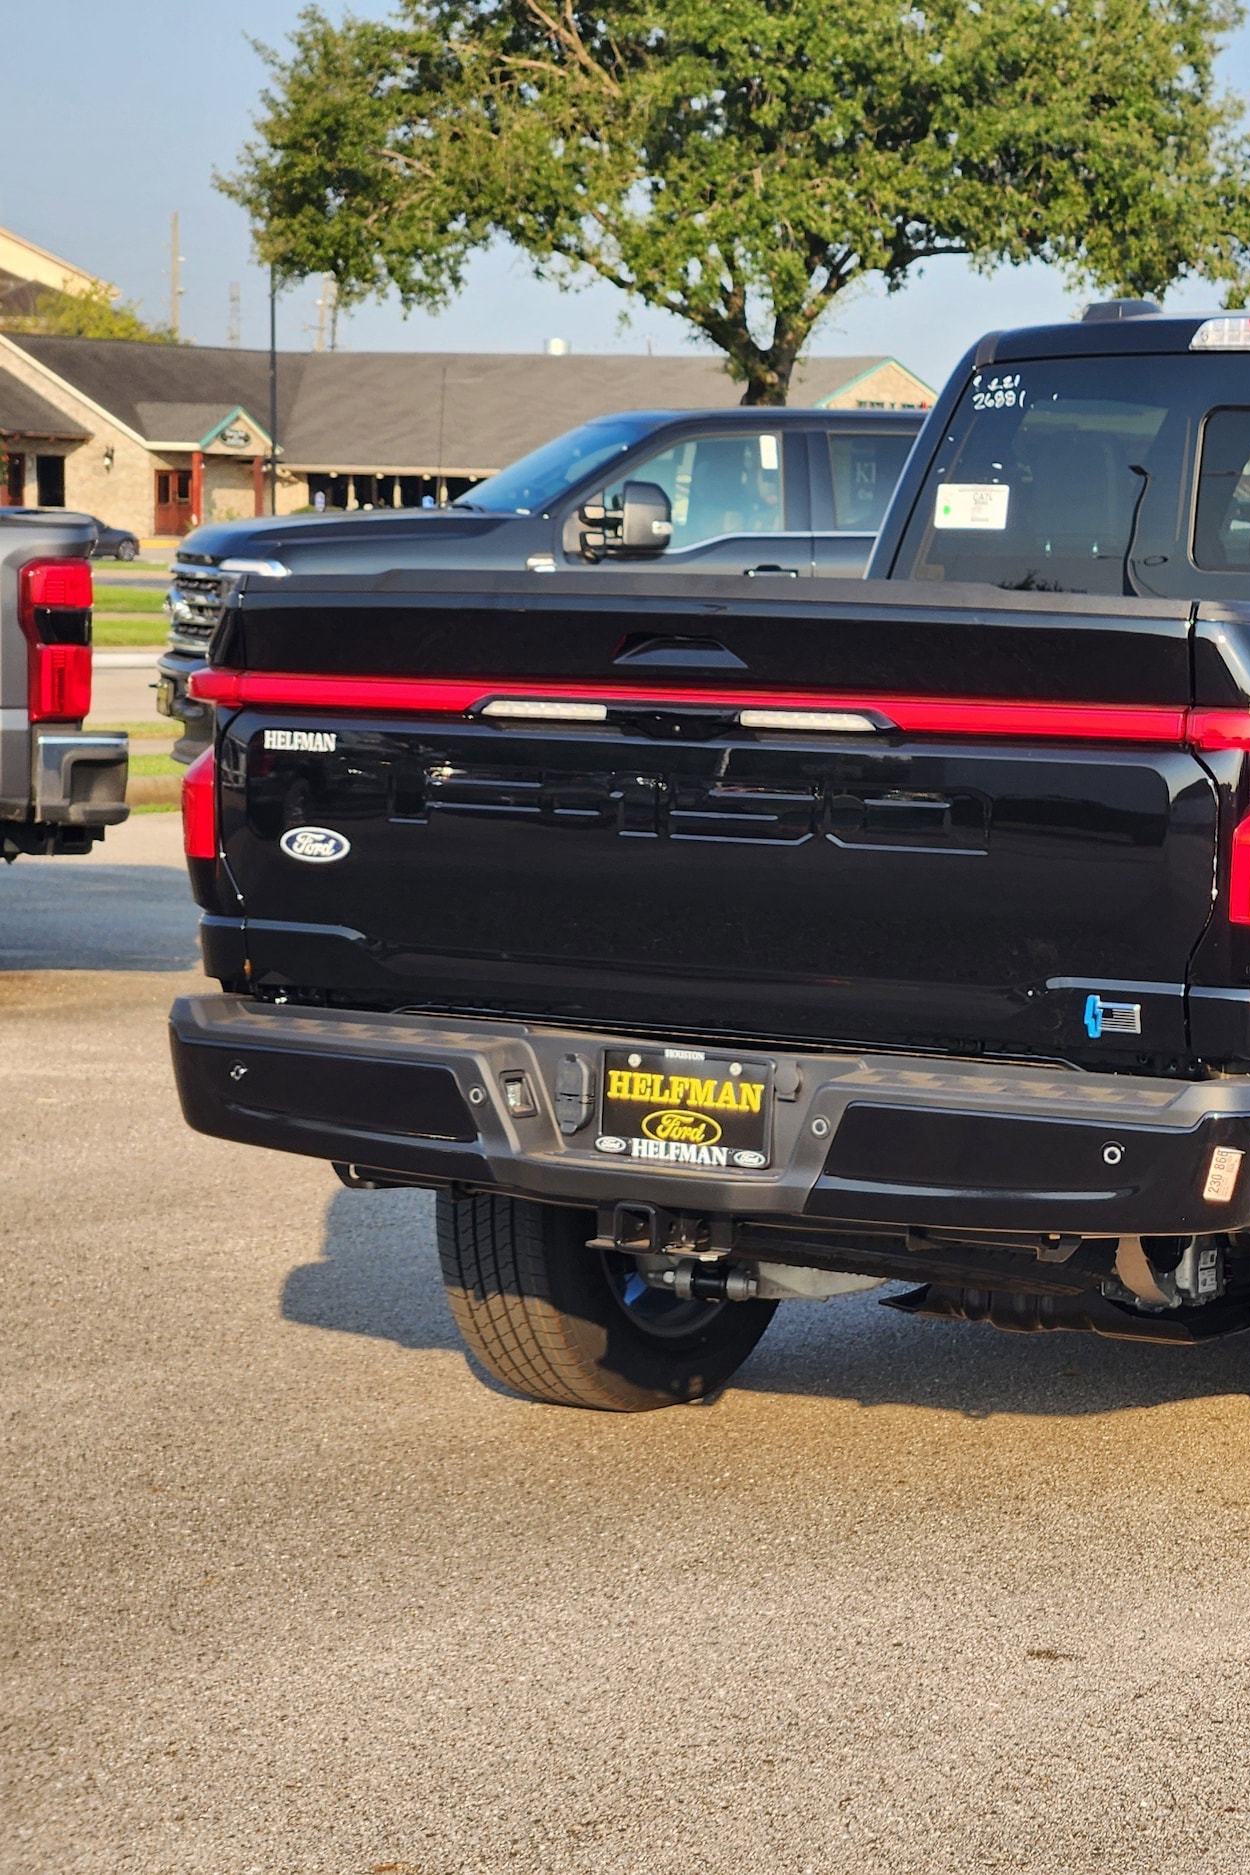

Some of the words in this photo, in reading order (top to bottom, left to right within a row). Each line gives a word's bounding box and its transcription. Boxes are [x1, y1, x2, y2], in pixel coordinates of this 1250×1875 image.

[263, 729, 337, 752] HELFMAN
[291, 831, 336, 857] Ford
[606, 1069, 765, 1113] HELFMAN
[655, 1112, 707, 1143] Ford
[630, 1137, 729, 1166] HELFMAN
[1207, 1173, 1223, 1194] 230
